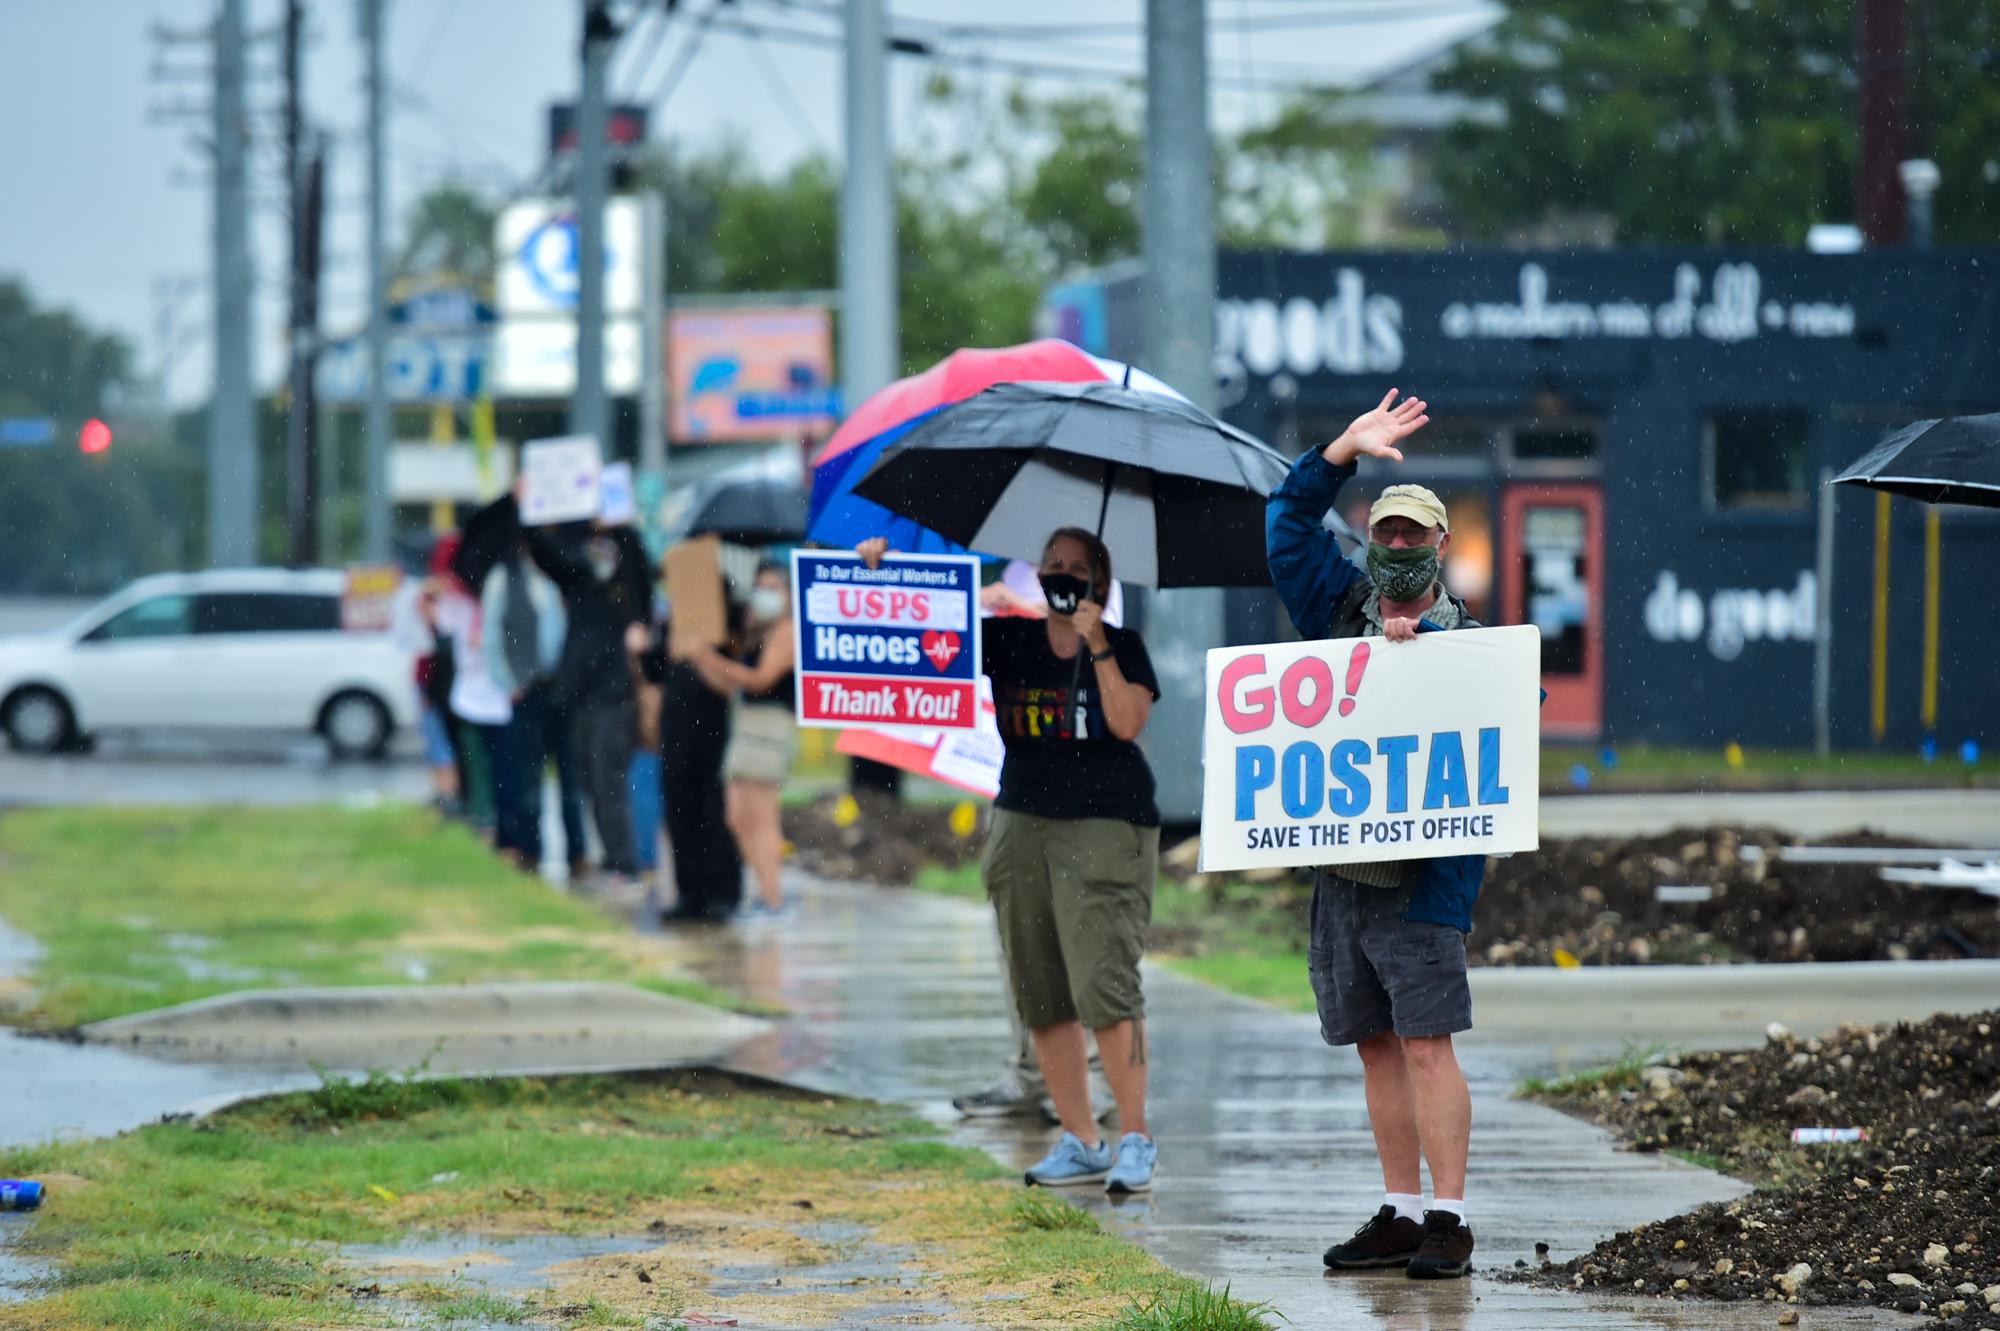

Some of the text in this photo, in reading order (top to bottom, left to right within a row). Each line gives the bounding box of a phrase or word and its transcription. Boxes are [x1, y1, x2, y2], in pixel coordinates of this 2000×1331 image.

[1654, 262, 1699, 338] of
[1210, 266, 1404, 406] goods
[815, 564, 958, 585] To Our Essential Workers &
[836, 588, 931, 623] USPS
[1645, 568, 1817, 662] do good
[815, 626, 921, 665] Heroes
[818, 681, 961, 721] Thank You!
[1217, 641, 1371, 735] GO!
[1235, 727, 1510, 822] POSTAL
[1247, 815, 1494, 850] SAVE THE POST OFFICE
